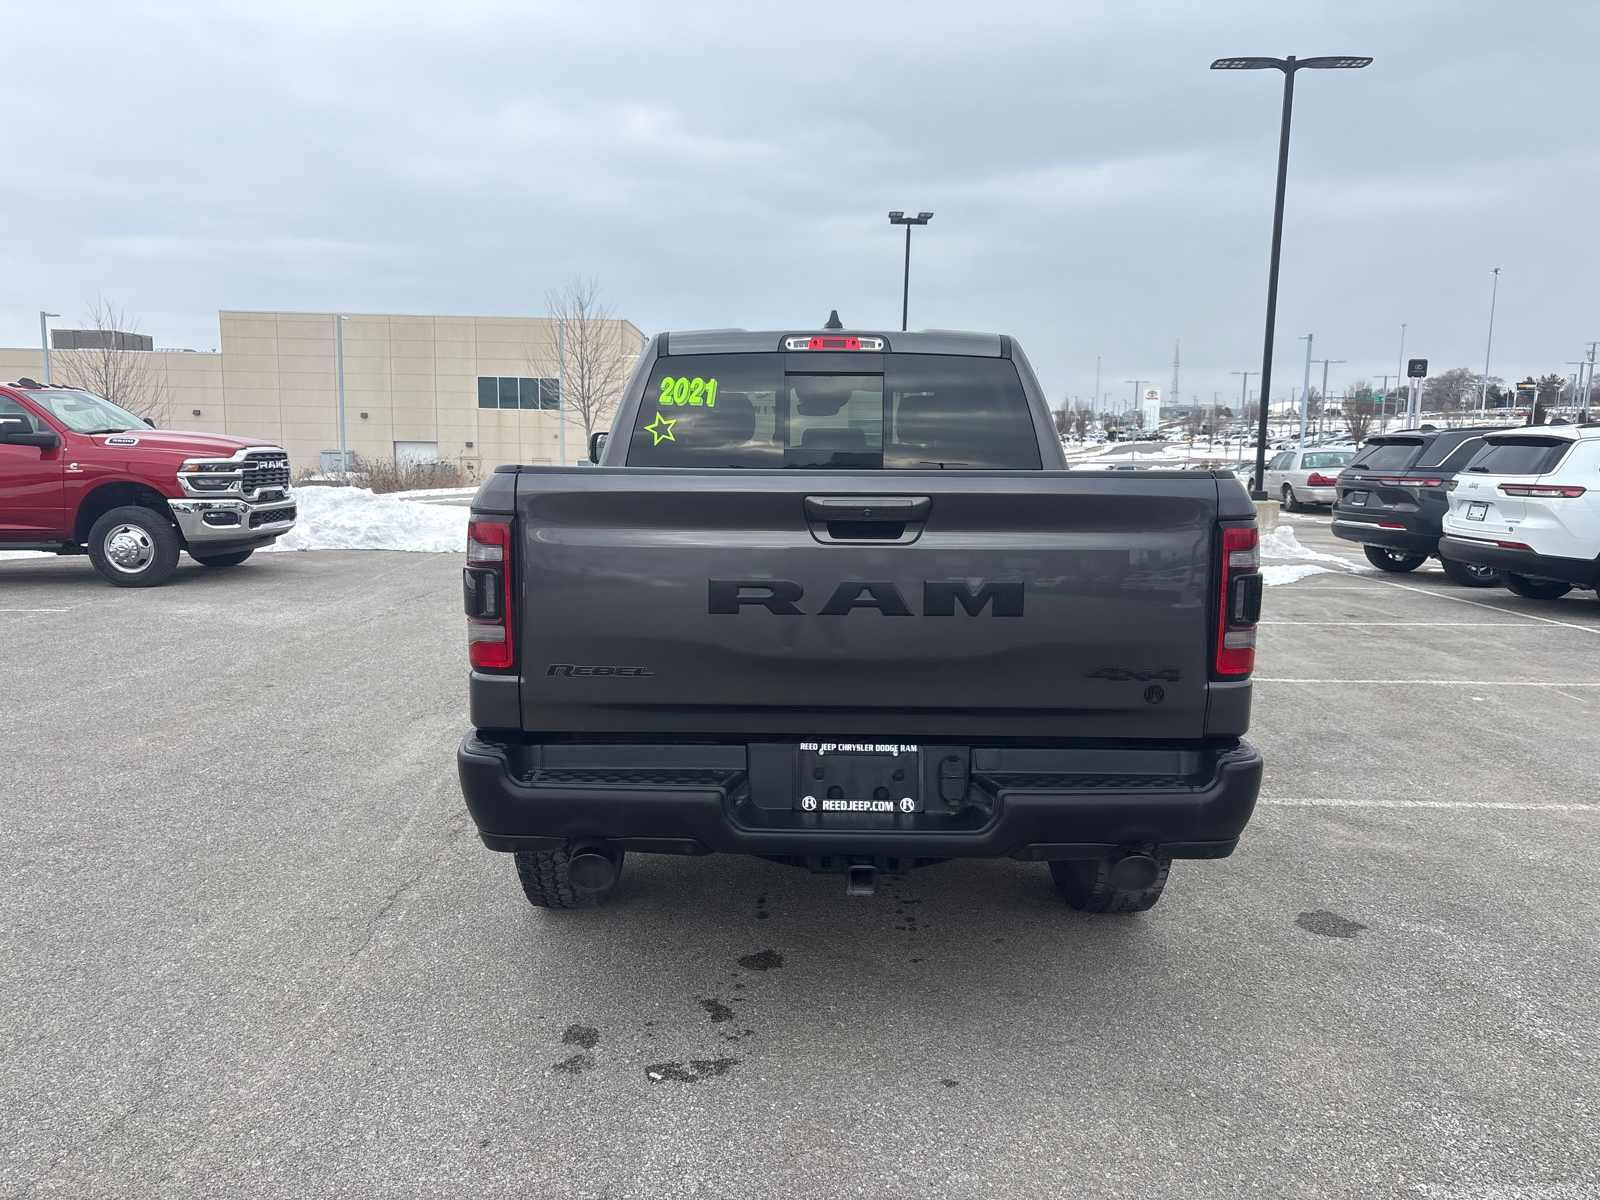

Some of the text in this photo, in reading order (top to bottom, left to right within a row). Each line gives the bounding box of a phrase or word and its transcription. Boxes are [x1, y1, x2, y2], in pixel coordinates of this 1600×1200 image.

[659, 376, 718, 407] 2021
[259, 460, 282, 469] RAM
[708, 578, 1025, 617] RAM
[545, 663, 657, 679] REBEL
[800, 742, 818, 751] REED
[820, 743, 837, 752] JEEP
[838, 744, 874, 752] CHRYSLER
[876, 745, 899, 753] DODGE
[822, 800, 894, 812] REEDJEEP.COM
